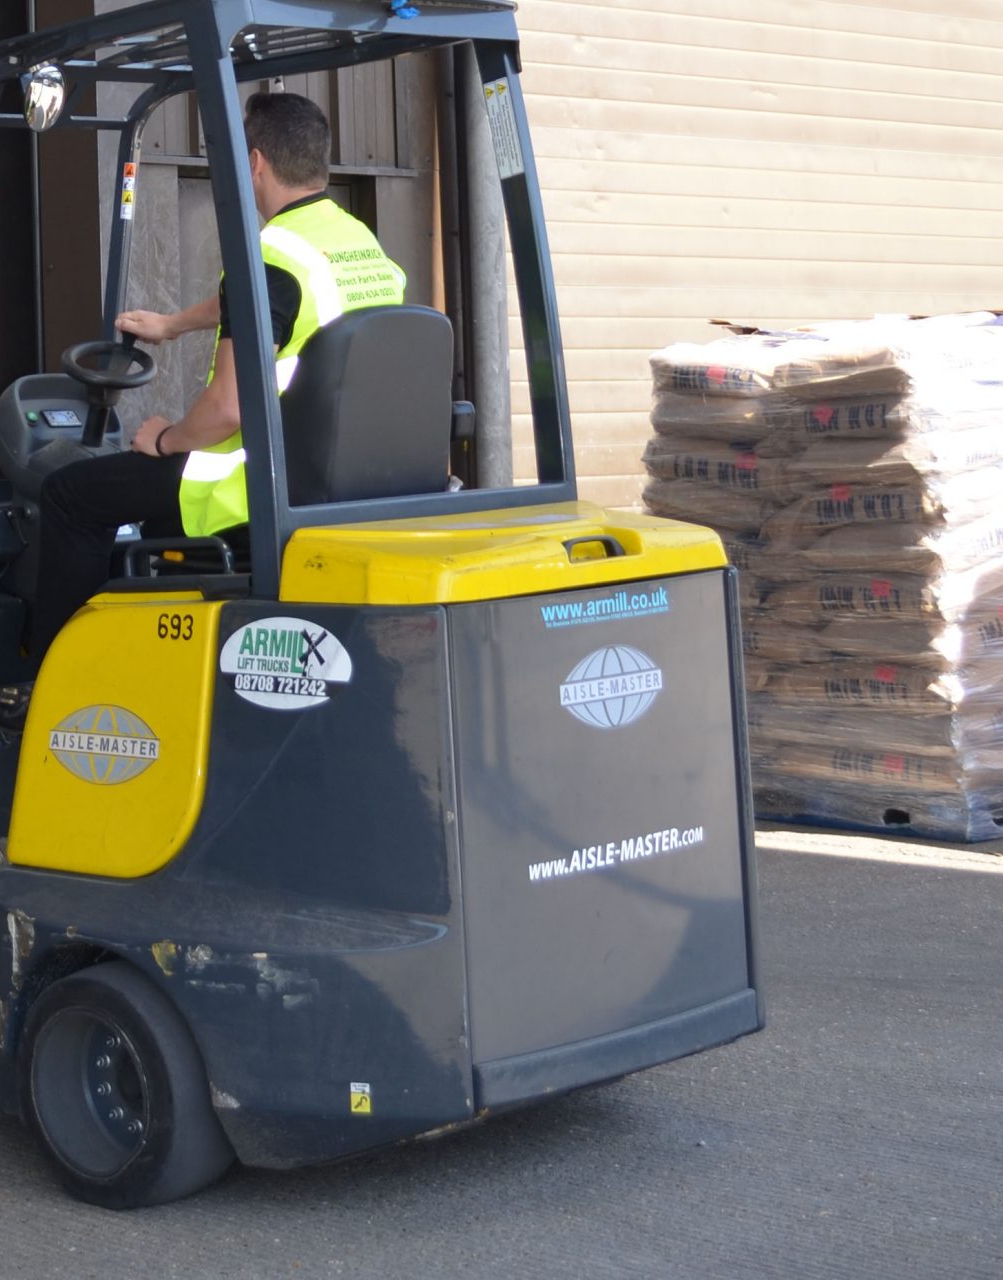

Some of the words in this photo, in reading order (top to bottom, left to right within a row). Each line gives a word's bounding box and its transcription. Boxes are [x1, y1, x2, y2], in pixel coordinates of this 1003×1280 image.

[541, 586, 668, 621] www.armill.co.uk
[157, 613, 194, 641] 693
[237, 657, 254, 670] LIFT
[256, 658, 289, 673] TRUCKS
[234, 674, 274, 693] 08708
[277, 677, 326, 697] 721242
[562, 672, 661, 702] AISLE-MASTER
[51, 733, 157, 757] AISLE-MASTER
